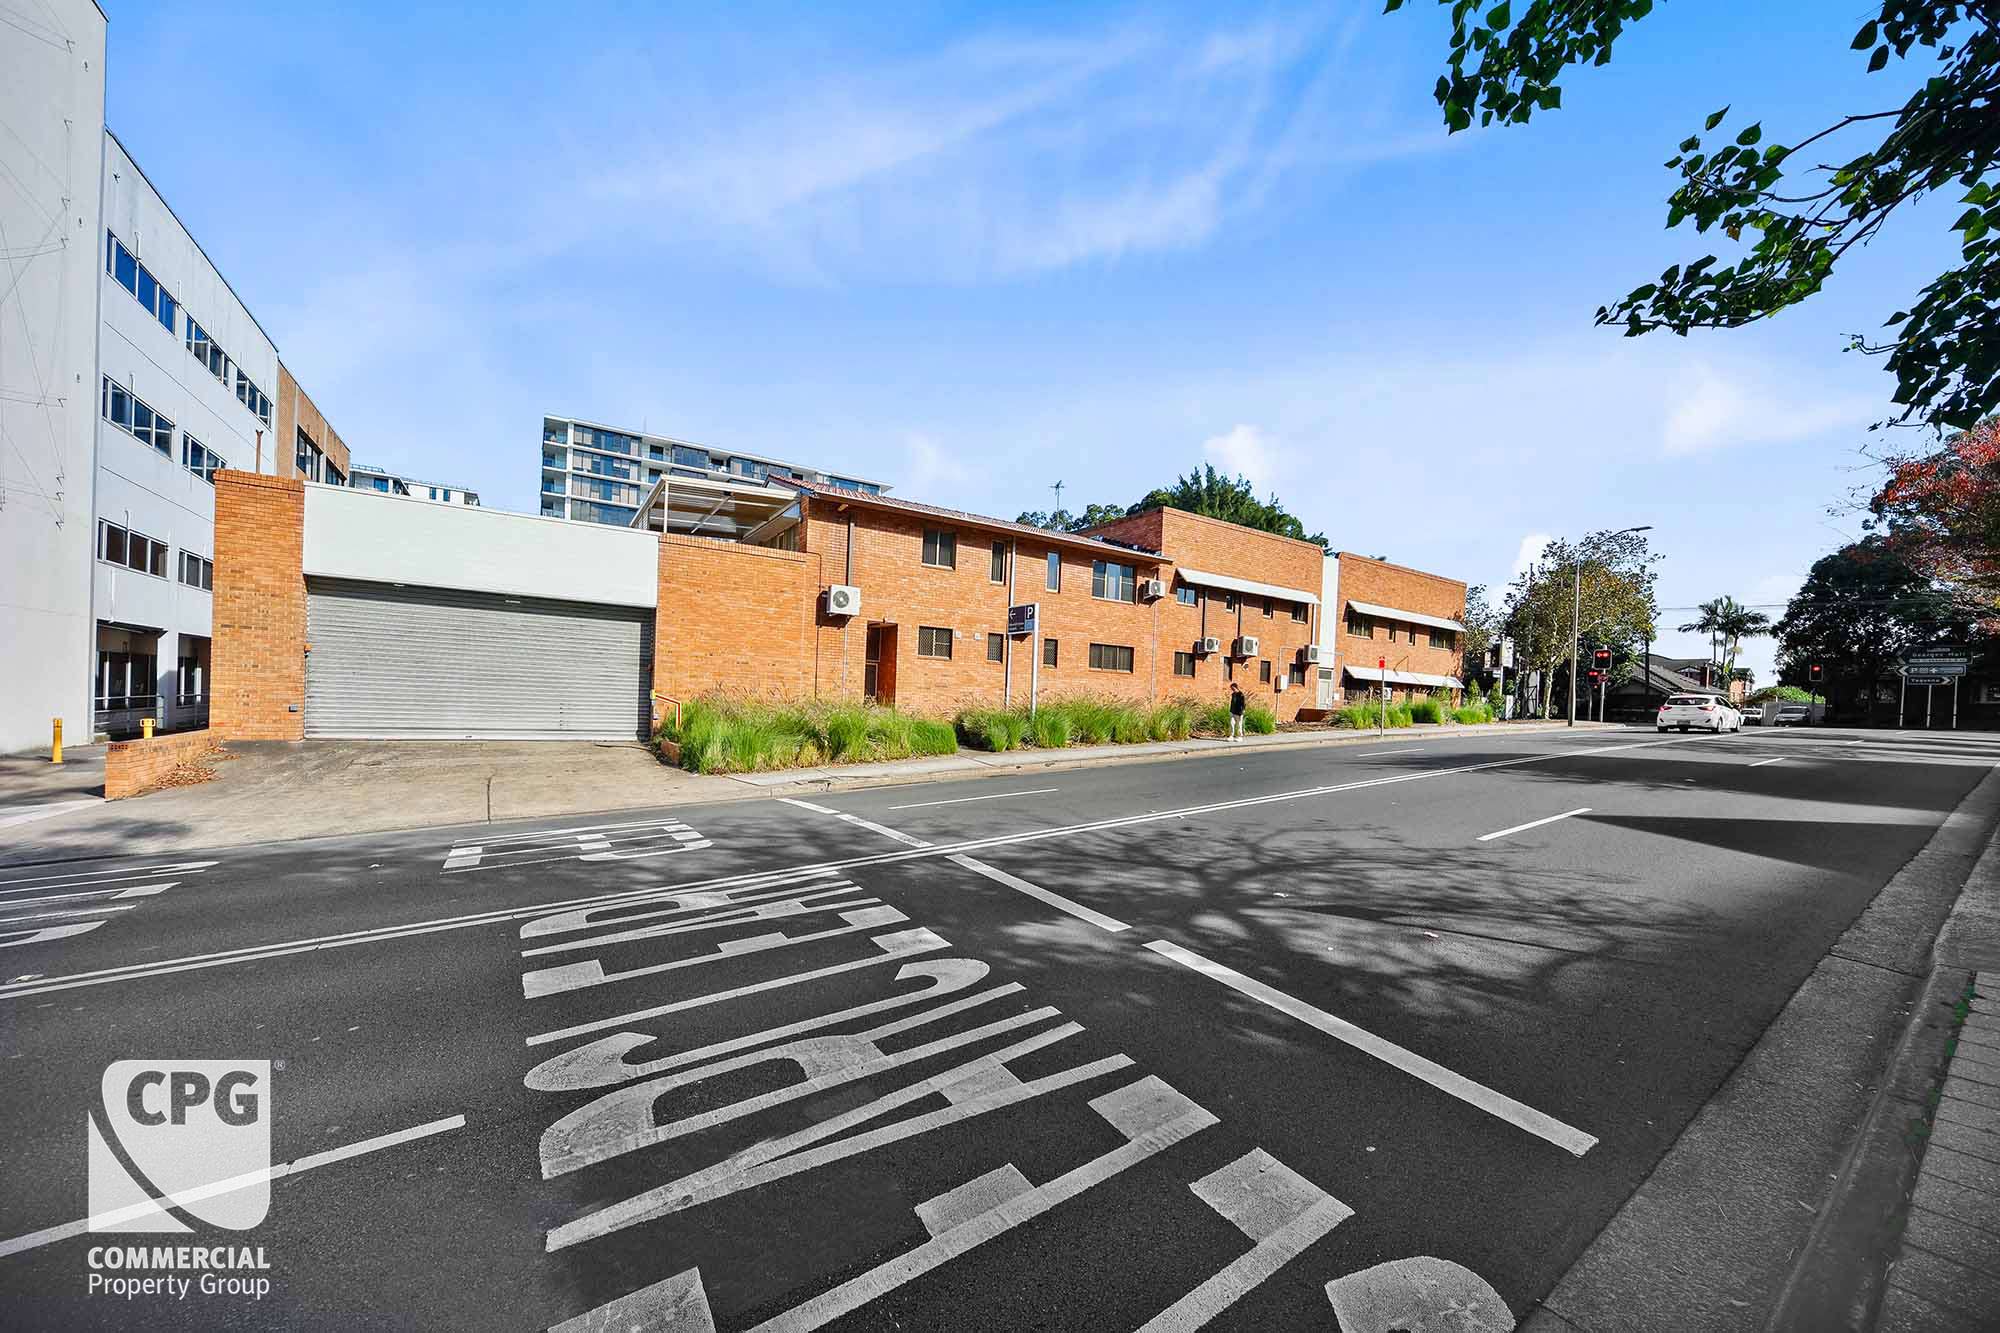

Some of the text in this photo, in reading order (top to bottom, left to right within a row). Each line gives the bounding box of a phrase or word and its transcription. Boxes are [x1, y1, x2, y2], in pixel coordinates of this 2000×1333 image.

[1027, 606, 1033, 619] P
[440, 818, 713, 874] KEEP
[520, 871, 990, 1092] CLEAR
[536, 982, 1517, 1333] EAR
